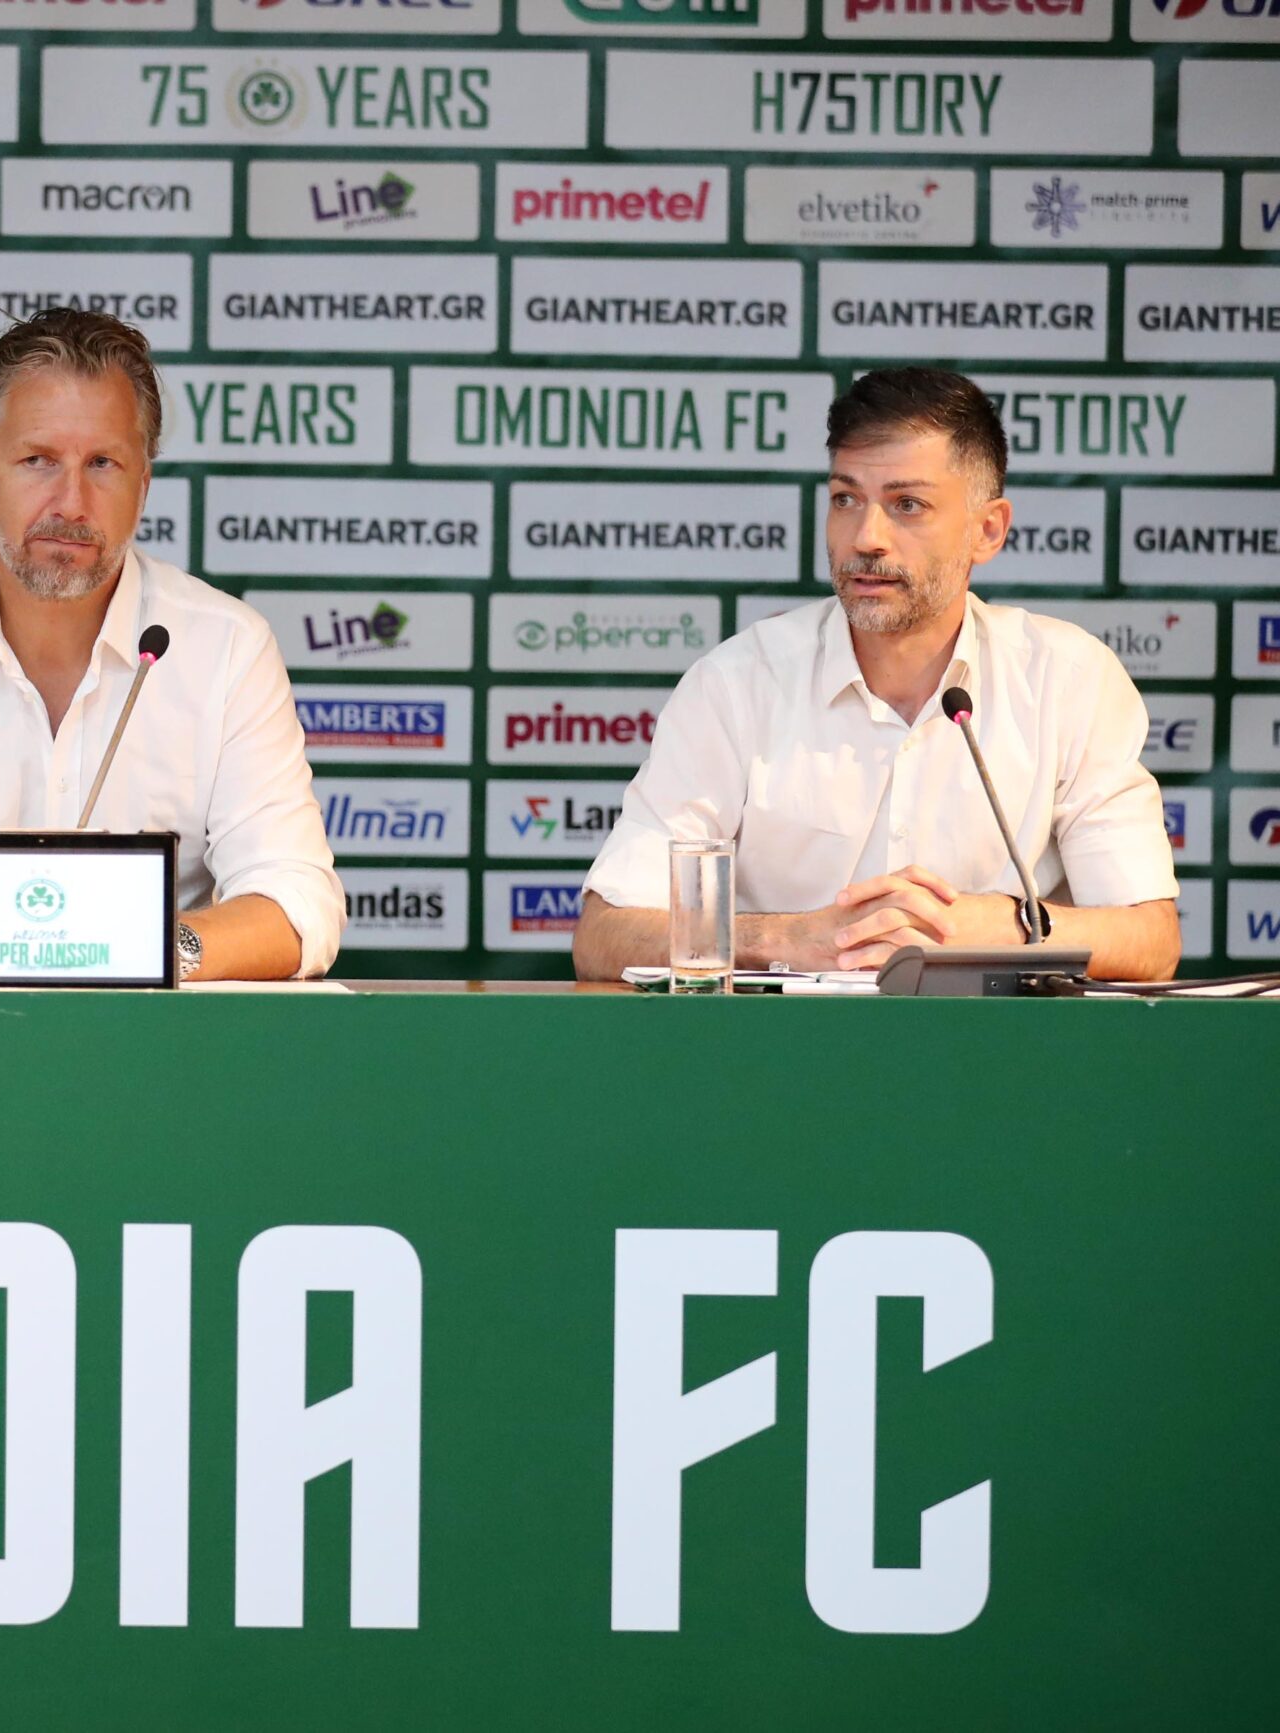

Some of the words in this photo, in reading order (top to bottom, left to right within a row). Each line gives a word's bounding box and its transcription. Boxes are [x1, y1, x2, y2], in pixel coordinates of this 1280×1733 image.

[142, 65, 208, 127] 75
[317, 66, 490, 129] YEARS
[754, 72, 1002, 135] H75TORY
[42, 184, 190, 211] macron
[309, 172, 406, 222] Line
[513, 179, 710, 225] primetel
[798, 190, 922, 223] elvetiko
[224, 294, 485, 320] GIANTHEART.GR
[526, 297, 787, 326] GIANTHEART.GR
[832, 300, 1094, 330] GIANTHEART.GR
[185, 382, 356, 445] YEARS
[456, 385, 702, 450] OMONOIA
[725, 390, 787, 452] FC
[218, 516, 478, 546] GIANTHEART.GR
[526, 522, 786, 549] GIANTHEART.GR
[303, 606, 402, 651] Line
[34, 942, 109, 967] JANSSON
[611, 1228, 994, 1634] FC
